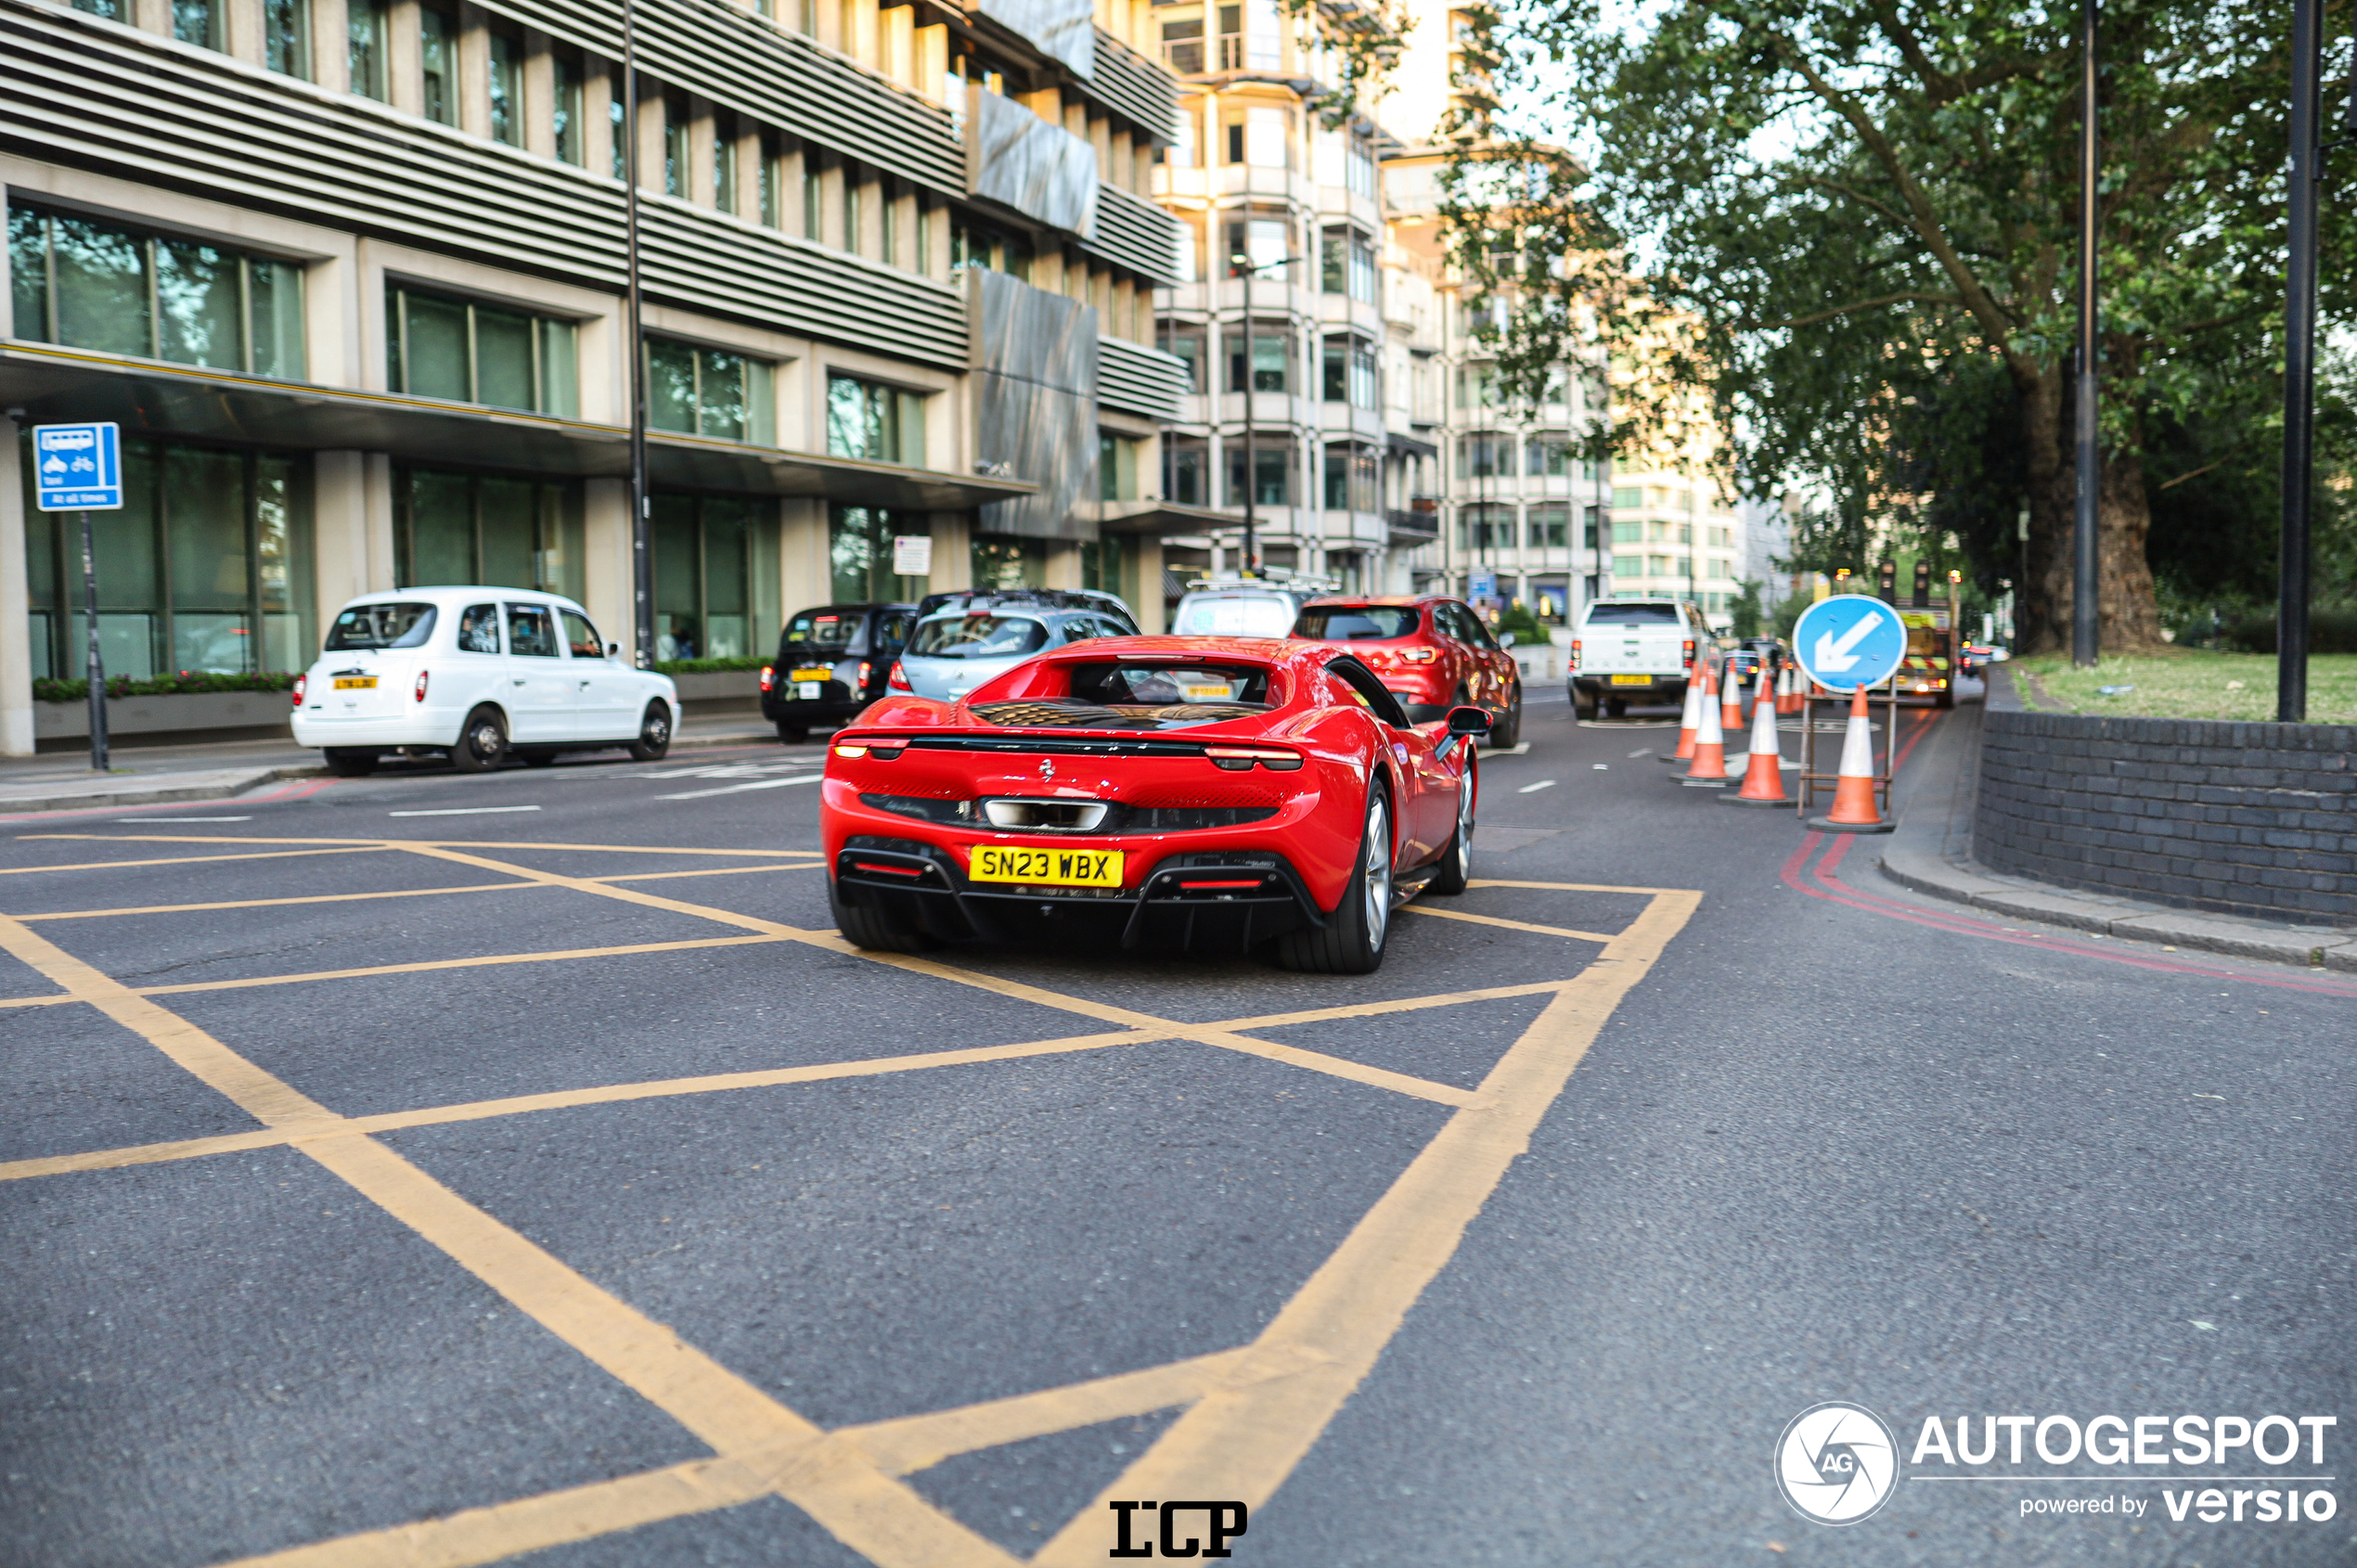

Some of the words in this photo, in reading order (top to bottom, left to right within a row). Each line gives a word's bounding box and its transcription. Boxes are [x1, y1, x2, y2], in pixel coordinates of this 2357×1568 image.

[80, 494, 108, 503] times
[983, 852, 1049, 877] SN23
[1060, 855, 1109, 880] WBX
